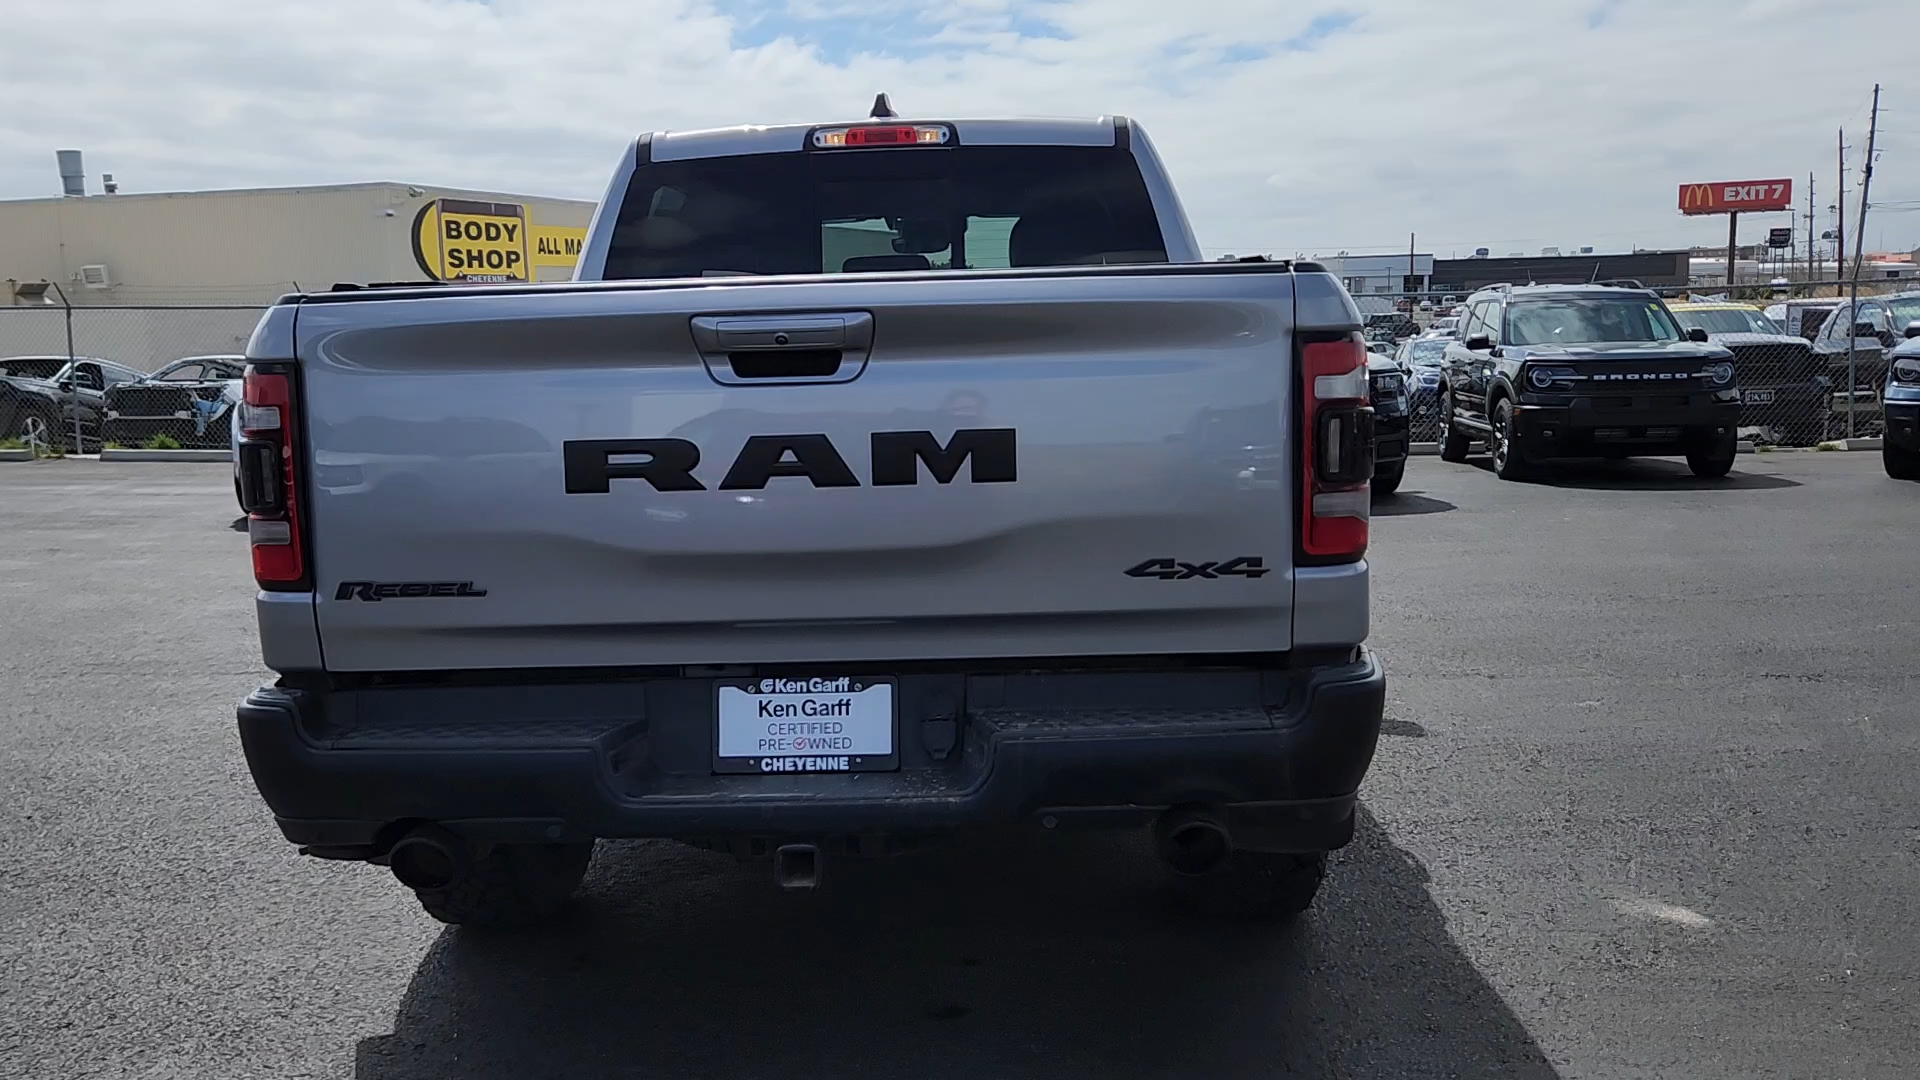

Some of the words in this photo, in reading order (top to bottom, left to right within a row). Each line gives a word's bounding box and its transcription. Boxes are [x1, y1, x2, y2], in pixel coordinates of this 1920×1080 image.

[1724, 185, 1769, 201] EXIT
[1771, 184, 1785, 199] 7
[445, 220, 518, 242] BODY
[538, 237, 561, 255] ALL
[448, 248, 521, 269] SHOP
[466, 275, 508, 283] CHEYENNE
[563, 428, 1017, 494] RAM
[1123, 557, 1271, 580] 4x4
[334, 581, 488, 602] REBEL
[775, 678, 807, 693] Ken
[809, 677, 850, 693] Garff
[758, 700, 798, 718] Ken
[801, 698, 852, 717] Garff
[767, 722, 843, 736] CERTIFIED
[761, 757, 850, 772] CHEYENNE
